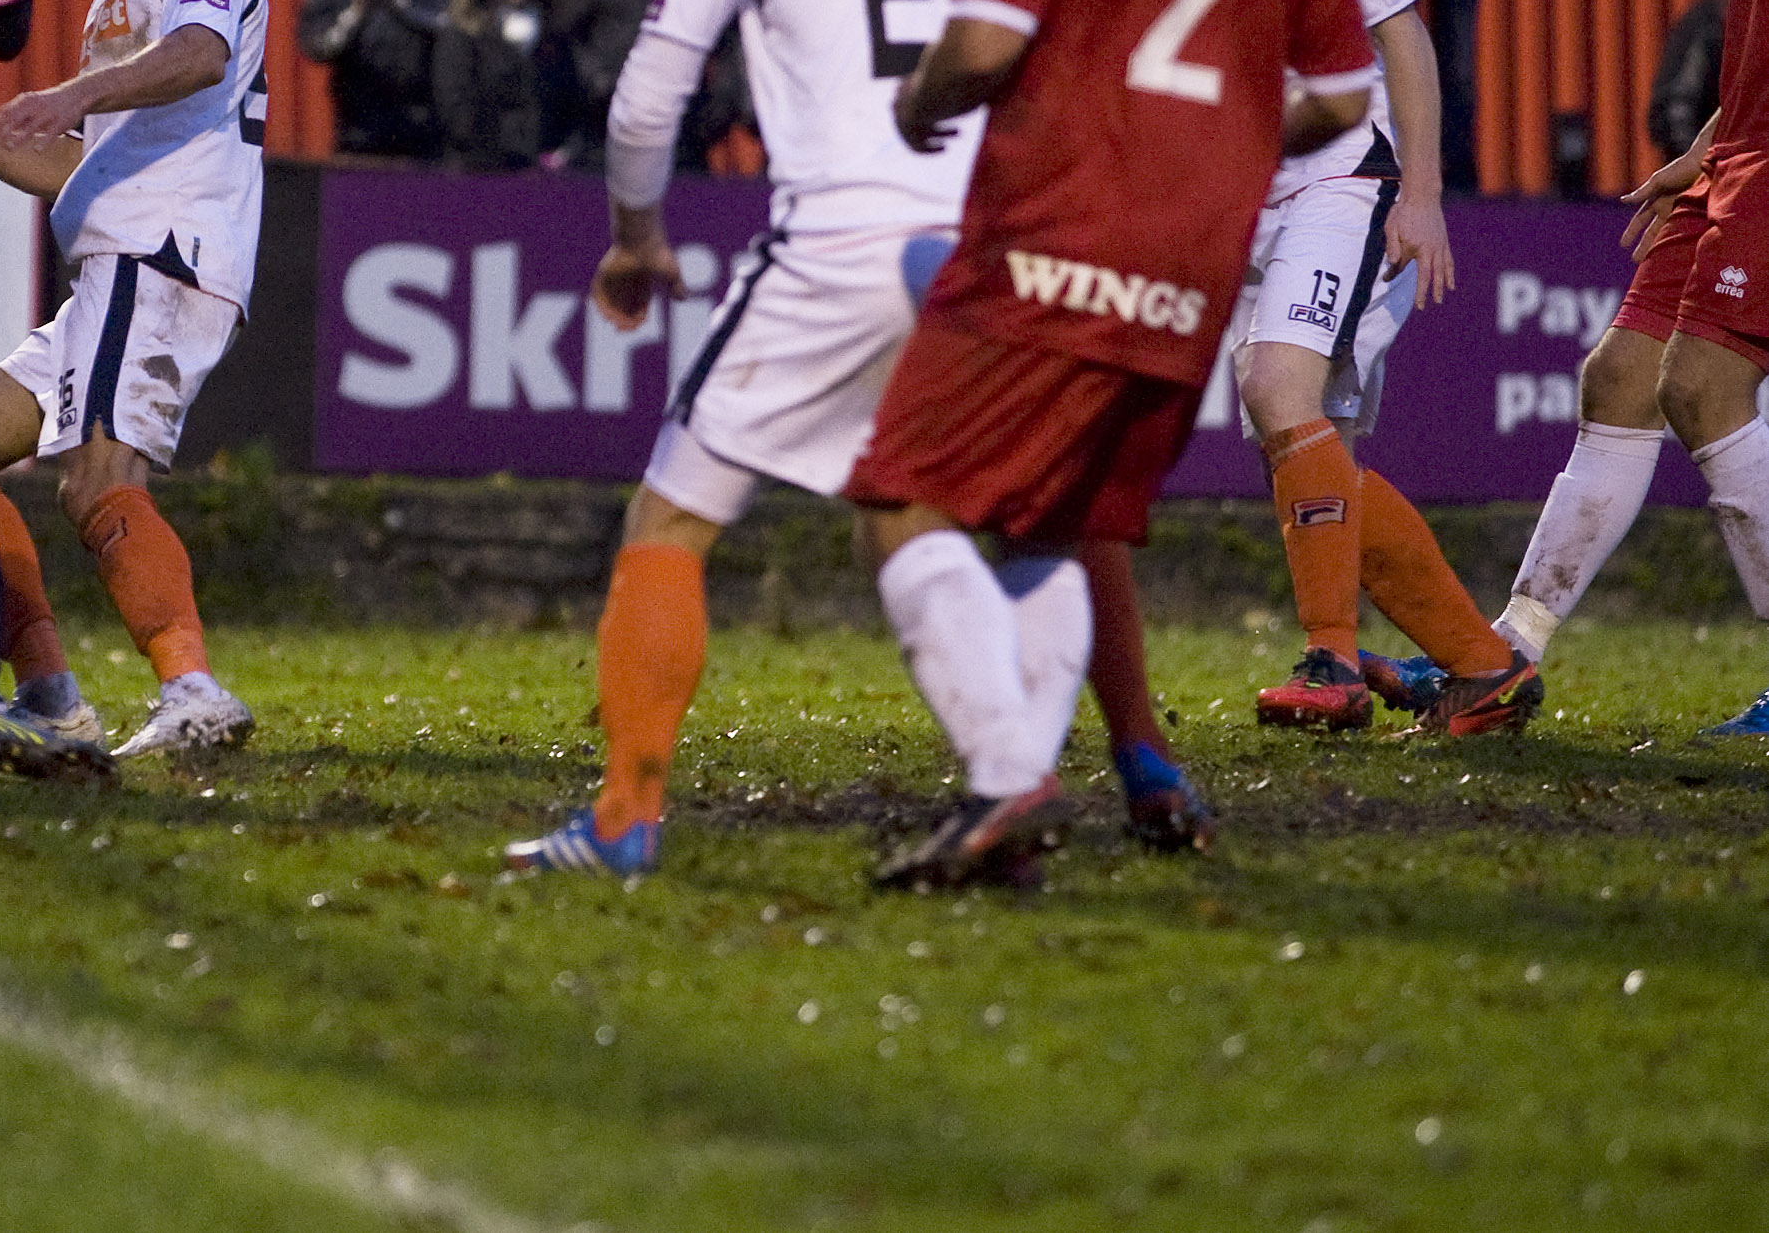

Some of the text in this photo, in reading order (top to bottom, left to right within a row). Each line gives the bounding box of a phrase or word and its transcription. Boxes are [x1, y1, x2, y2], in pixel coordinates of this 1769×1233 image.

[1005, 249, 1209, 337] WINGS
[1294, 308, 1331, 327] FILA
[1311, 269, 1341, 312] 13
[1496, 270, 1621, 350] Pay
[1715, 282, 1745, 299] errea
[336, 240, 746, 413] Skri
[1495, 371, 1580, 436] pa
